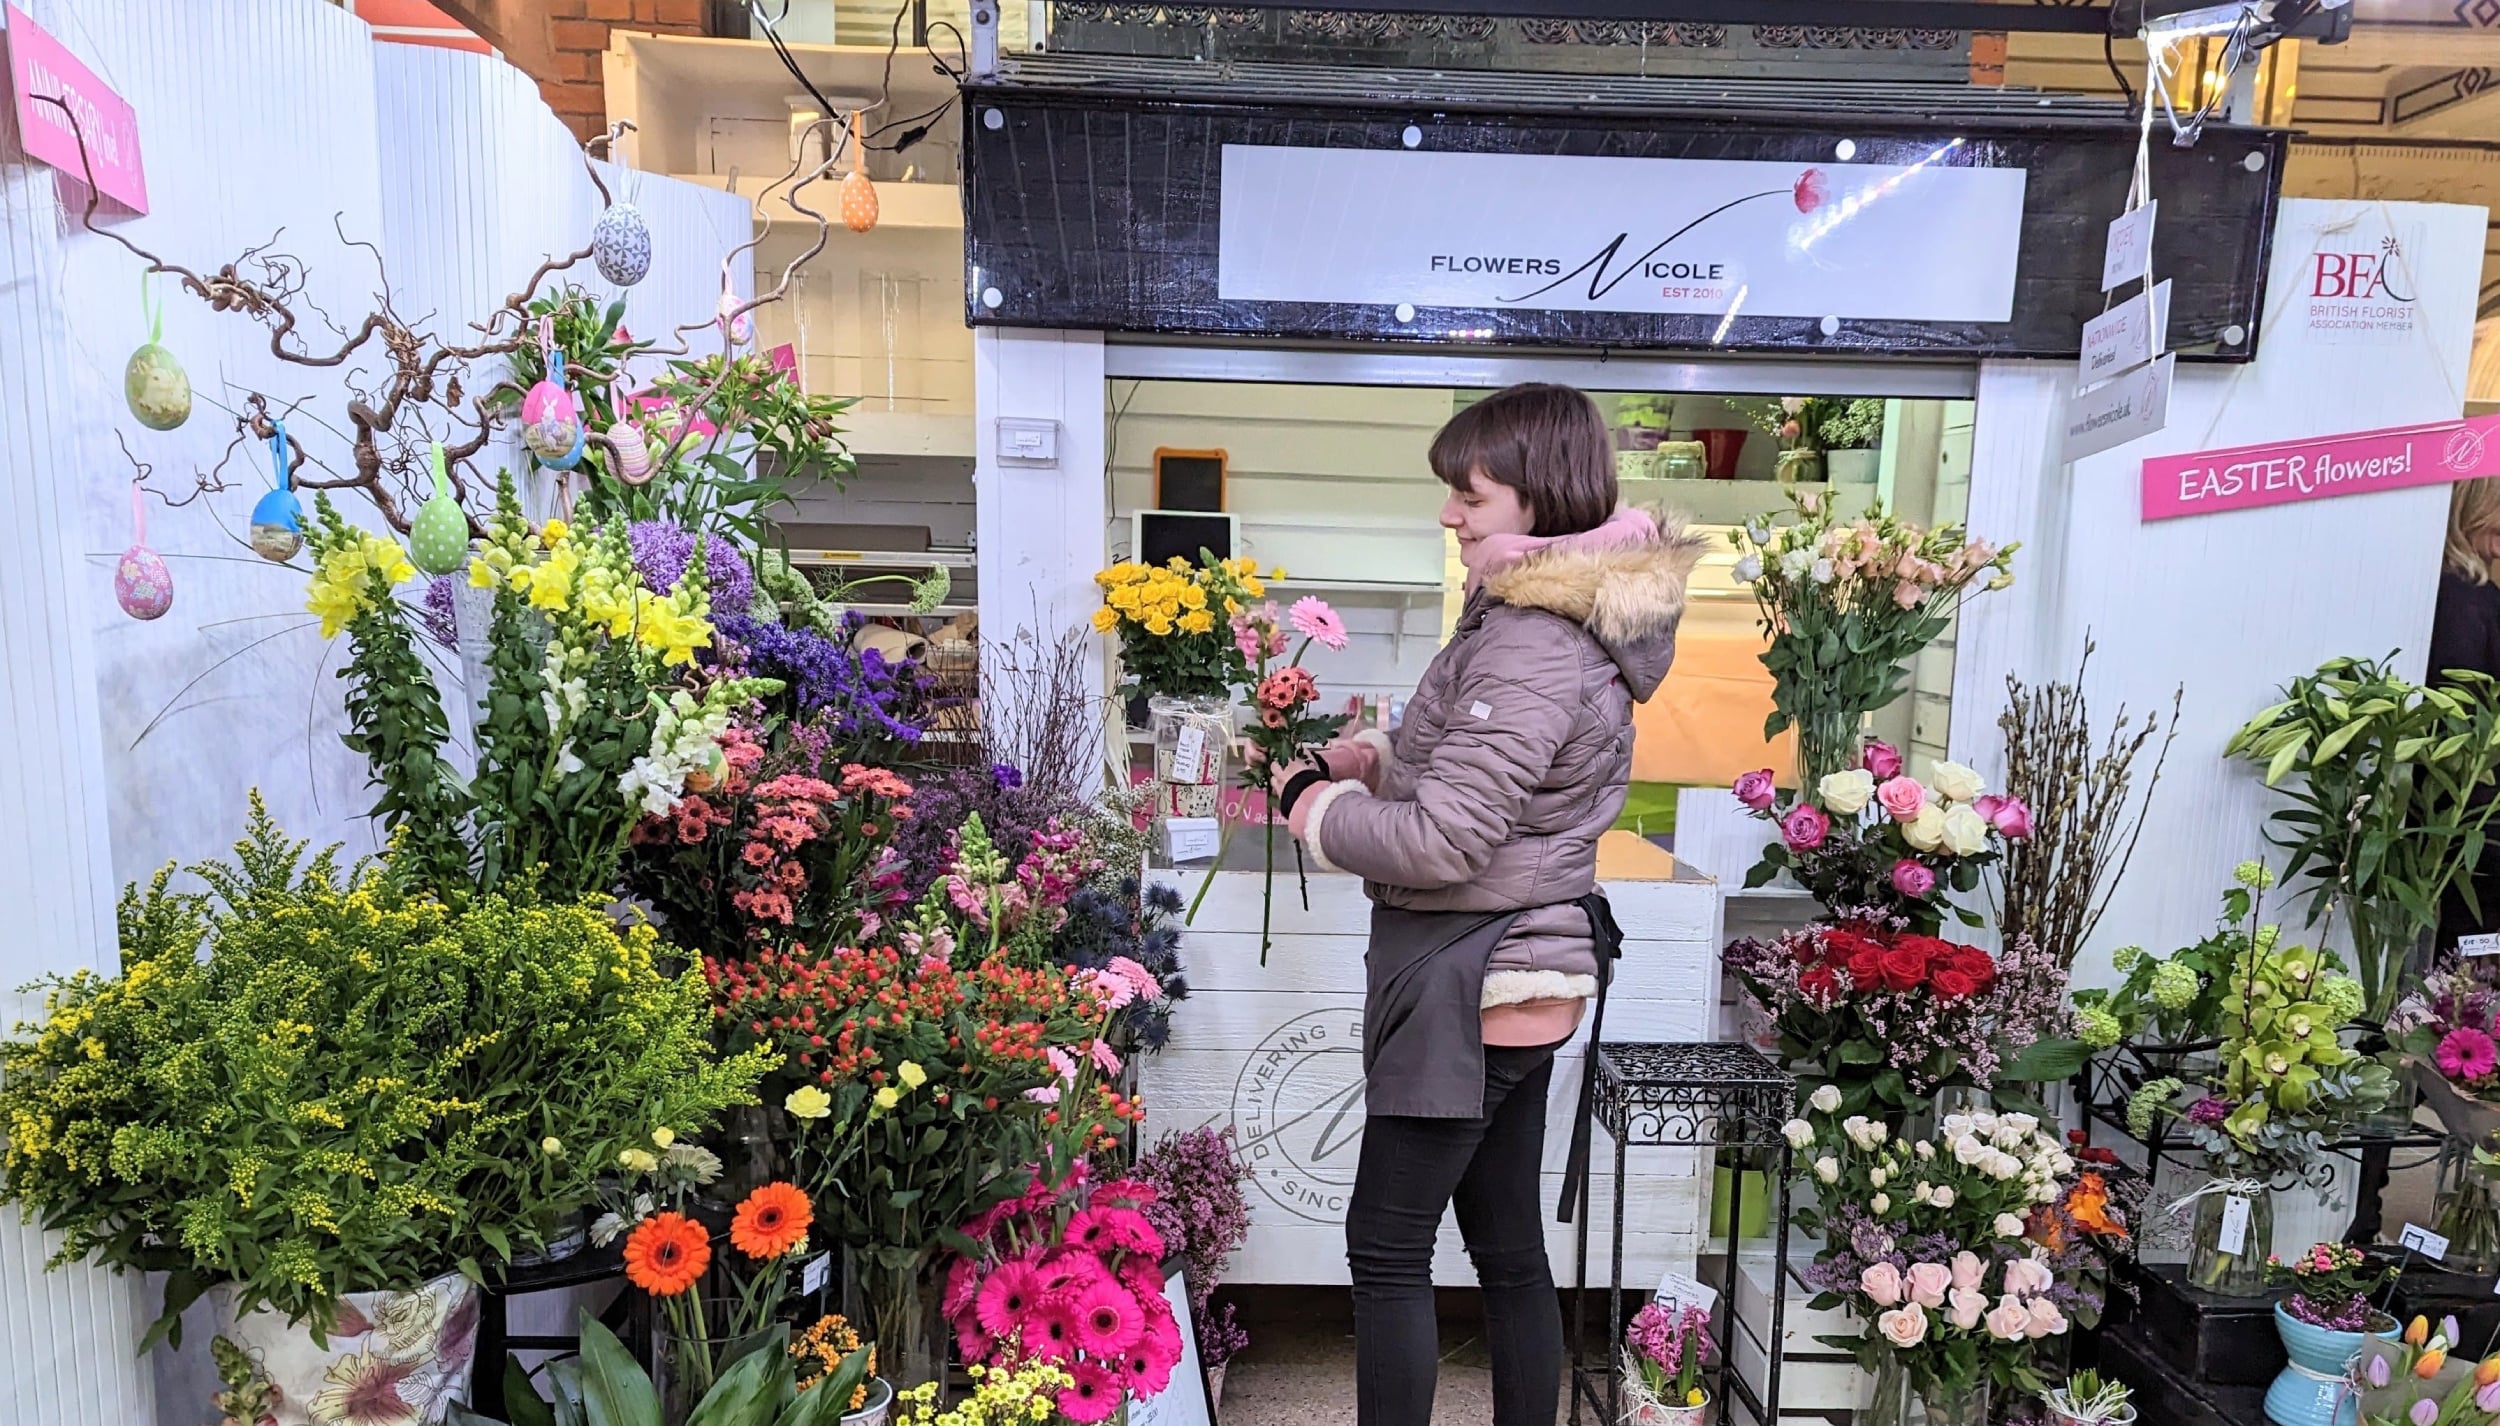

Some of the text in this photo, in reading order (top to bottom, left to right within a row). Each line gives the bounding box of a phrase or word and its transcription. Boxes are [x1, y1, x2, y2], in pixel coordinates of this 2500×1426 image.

[1431, 255, 1561, 275] FLOWERS
[2309, 242, 2416, 302] BFA
[1662, 287, 1690, 298] EST
[2309, 319, 2413, 331] ASSOCIATION MEMBER
[2310, 305, 2414, 320] BRITISH FLORIST
[2178, 455, 2314, 501] EASTER
[2313, 442, 2413, 486] flowers!
[1245, 1024, 1327, 1161] DELIVERING
[1281, 1180, 1353, 1212] SINC
